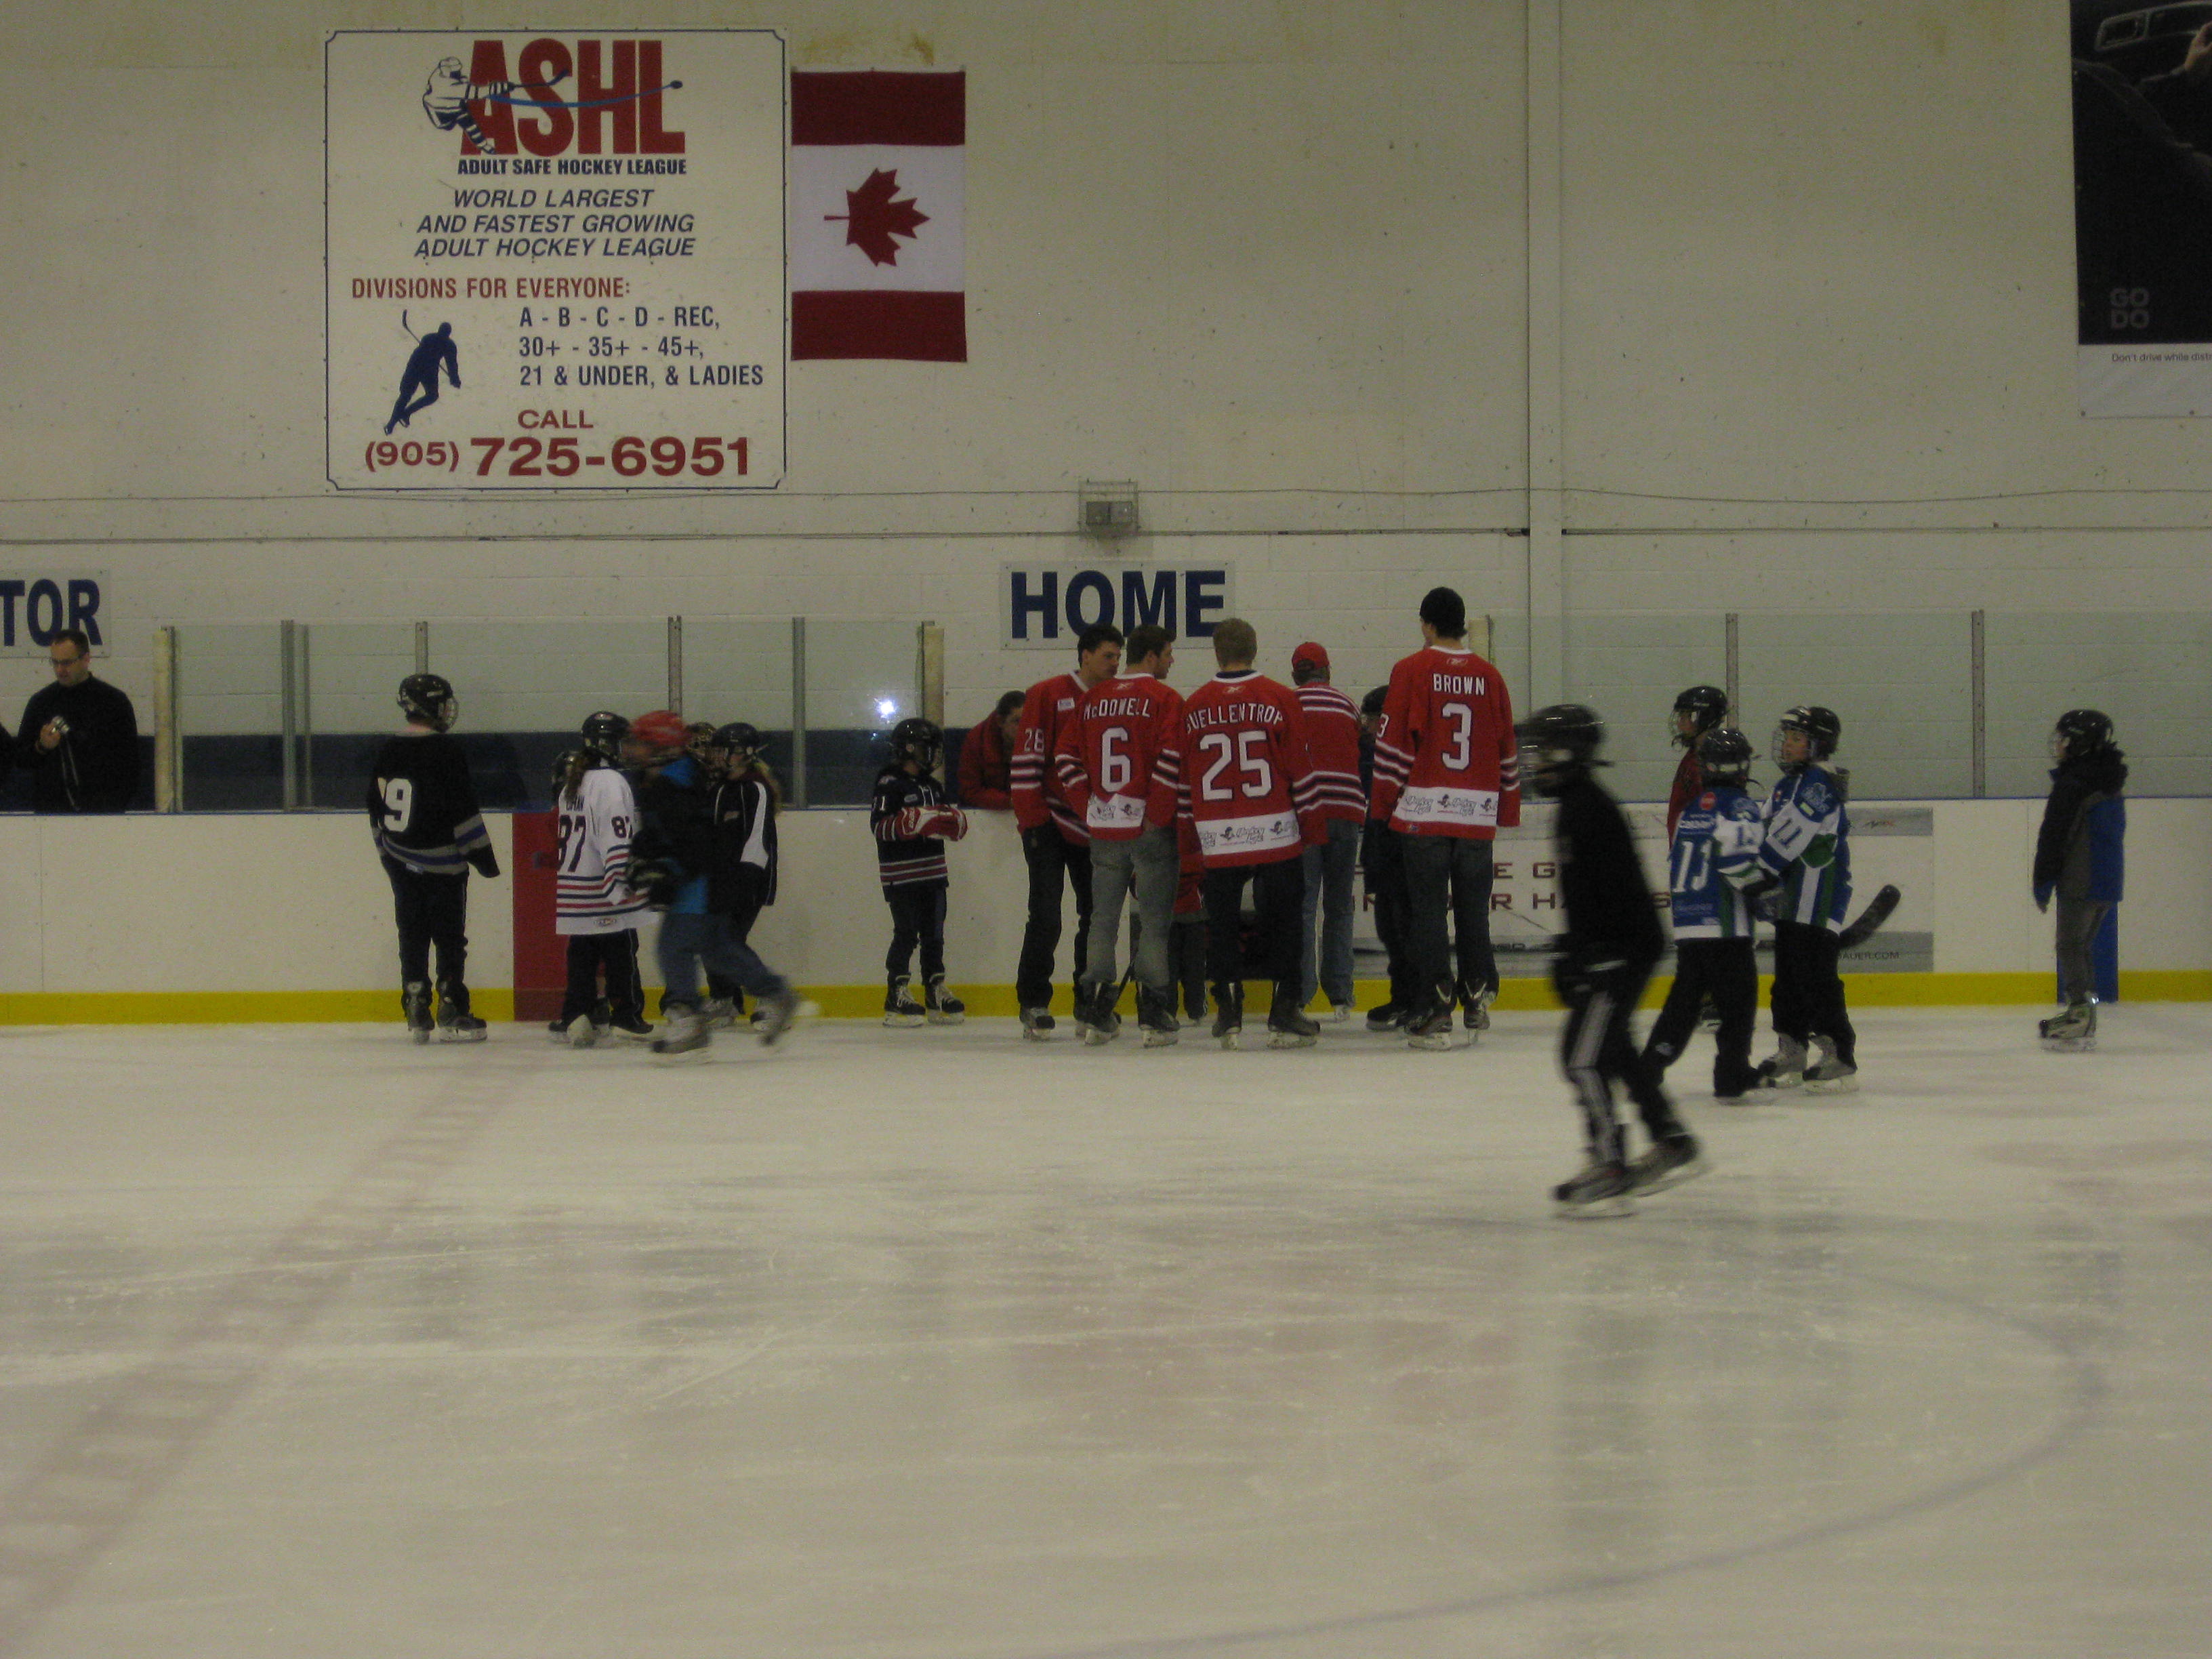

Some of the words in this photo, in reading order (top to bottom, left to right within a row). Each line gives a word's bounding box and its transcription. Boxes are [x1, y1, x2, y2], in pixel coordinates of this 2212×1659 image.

[459, 39, 685, 157] ASHL
[458, 160, 508, 174] ADULT
[513, 159, 550, 174] SAFE
[558, 160, 622, 175] HOCKEY
[628, 159, 686, 174] LEAGUE
[455, 190, 536, 207] WORLD
[546, 189, 655, 207] LARGEST
[417, 216, 466, 232] AND
[474, 215, 575, 233] FASTEST
[583, 214, 694, 232] GROWING
[415, 239, 489, 257] ADULT
[496, 239, 595, 257] HOCKEY
[603, 238, 695, 257] LEAGUE
[352, 278, 456, 298] DIVISIONS
[468, 278, 506, 298] FOR
[517, 277, 629, 298] EVERYONE:
[520, 307, 532, 327] A
[559, 307, 570, 327] B
[597, 307, 608, 327] C
[636, 307, 647, 327] D
[675, 306, 718, 329] REC,
[520, 337, 560, 356] 30+
[589, 337, 629, 356] 35+
[658, 337, 703, 358] 45+,
[520, 366, 541, 386] 21
[554, 366, 567, 386] &
[579, 366, 654, 387] UNDER,
[665, 366, 678, 386] &
[690, 365, 762, 385] LADIES
[518, 410, 593, 429] CALL
[366, 442, 459, 472] (905)
[471, 437, 747, 476] 725-6951
[1011, 570, 1225, 639] HOME
[1433, 674, 1485, 695] BROWN
[1442, 703, 1472, 770] 3
[1102, 727, 1130, 792] 6
[1200, 731, 1272, 801] 25
